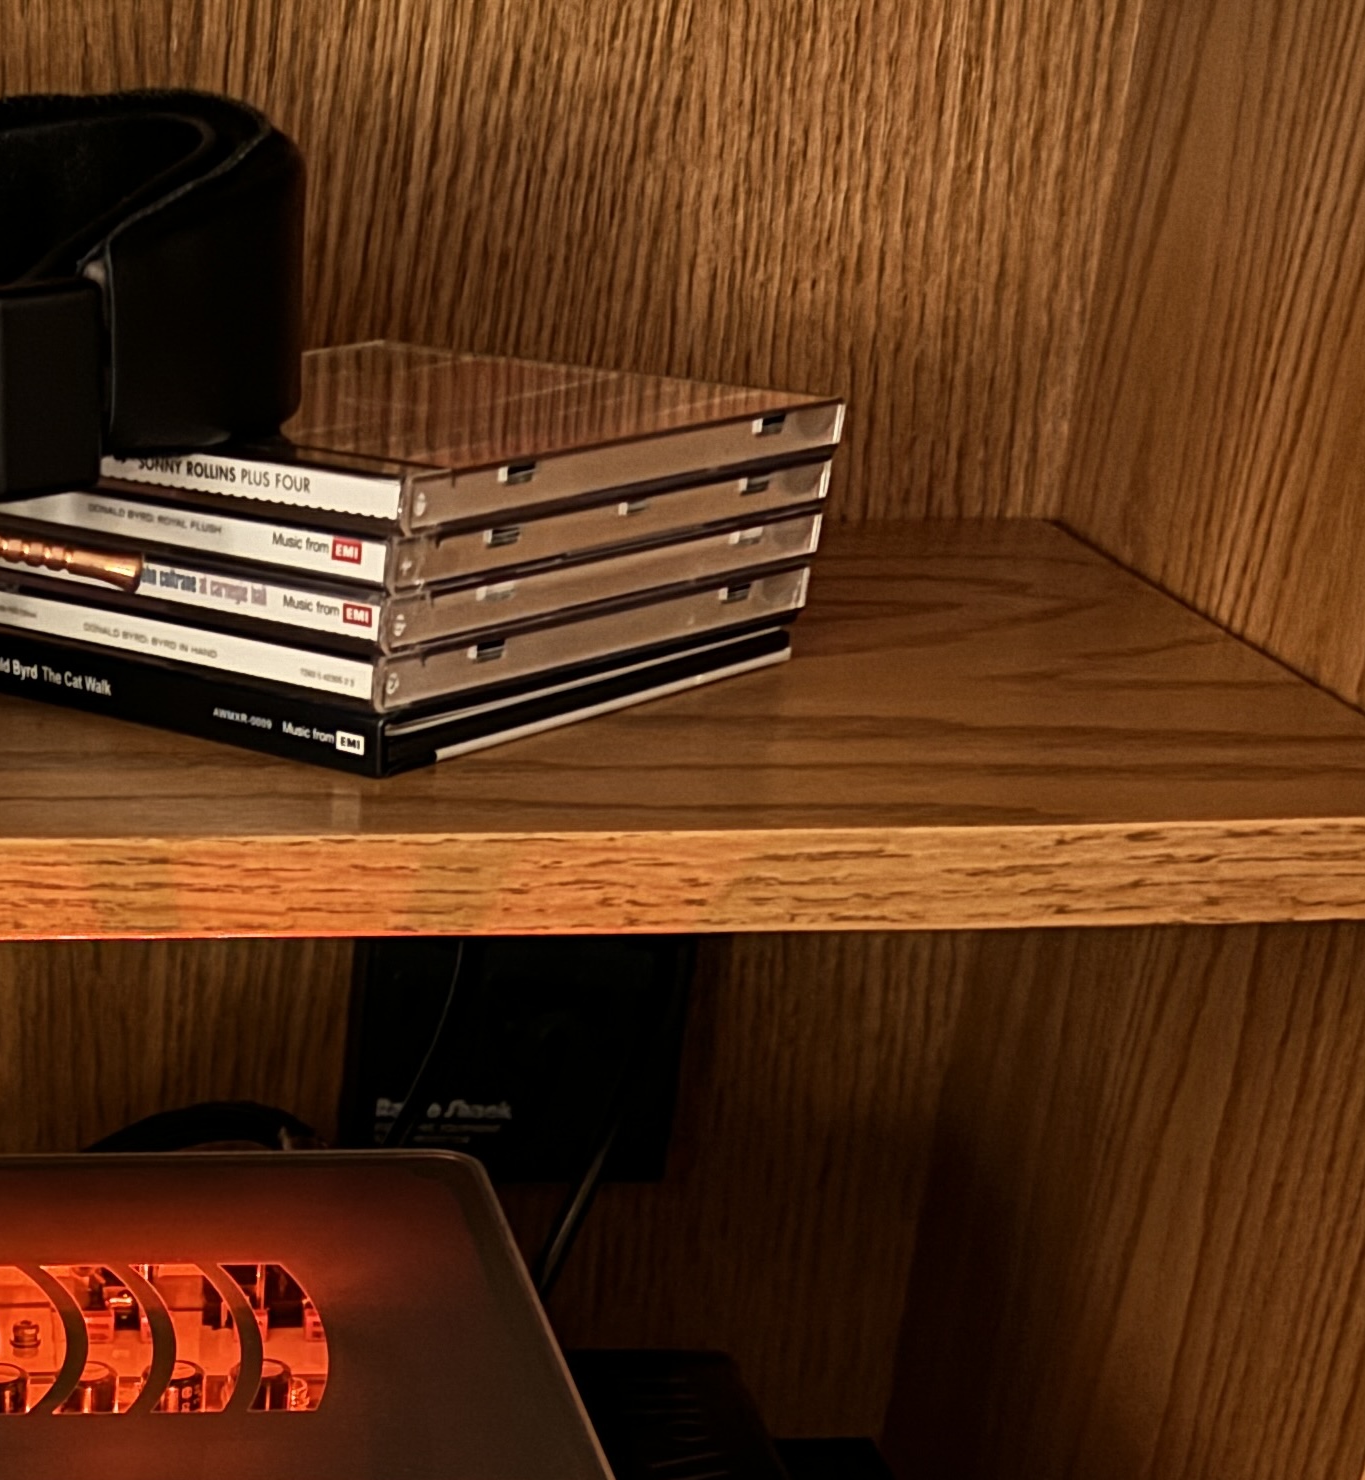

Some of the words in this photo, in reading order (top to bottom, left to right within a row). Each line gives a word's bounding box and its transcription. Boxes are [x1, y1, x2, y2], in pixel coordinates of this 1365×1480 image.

[138, 457, 182, 475] SONNY
[186, 459, 236, 483] ROLLINS
[241, 468, 270, 488] PLUS
[275, 472, 311, 493] FOUR
[88, 503, 125, 518] DONALD
[157, 515, 187, 529] ROYAL
[190, 520, 223, 534] FLUSH
[272, 532, 303, 550] Music
[305, 537, 330, 555] from
[335, 541, 359, 560] EMI
[283, 594, 314, 612] Music
[316, 600, 340, 616] from
[345, 607, 370, 622] EMI
[83, 621, 120, 638] DONALD
[151, 636, 177, 650] BYRD
[191, 645, 218, 659] HAND
[12, 659, 38, 680] Byrd
[42, 665, 62, 685] The
[64, 671, 83, 690] Cat
[84, 675, 112, 696] Walk
[281, 720, 311, 739] Music
[312, 727, 335, 745] from
[340, 736, 362, 751] EMI
